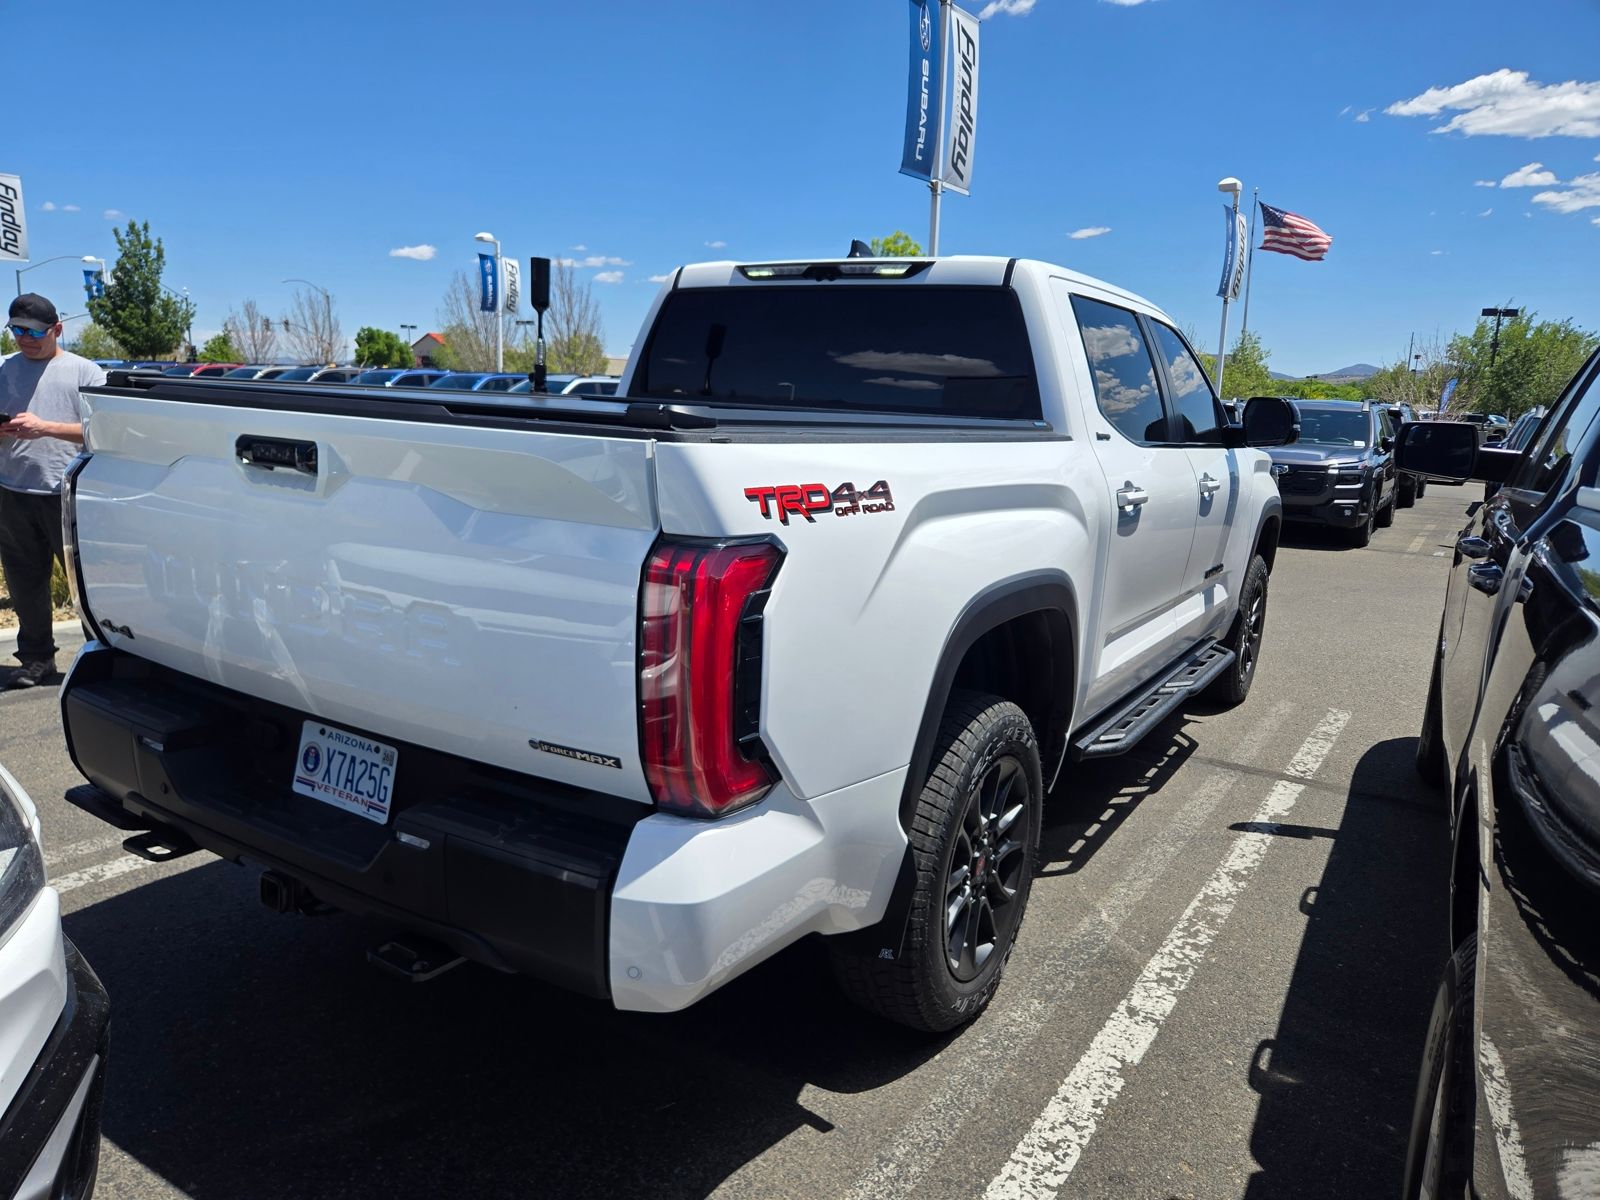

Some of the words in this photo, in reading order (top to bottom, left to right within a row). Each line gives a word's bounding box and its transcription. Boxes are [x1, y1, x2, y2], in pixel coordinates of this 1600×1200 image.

[915, 58, 930, 161] SUBARU
[952, 19, 976, 182] Findlay
[0, 182, 21, 256] Findlay
[506, 261, 519, 313] Findlay
[743, 483, 834, 526] TRD
[835, 504, 861, 517] OFF
[862, 502, 895, 514] ROAD
[327, 730, 373, 754] ARIZONA
[315, 783, 370, 808] VETERAN
[321, 746, 391, 804] X7A25G
